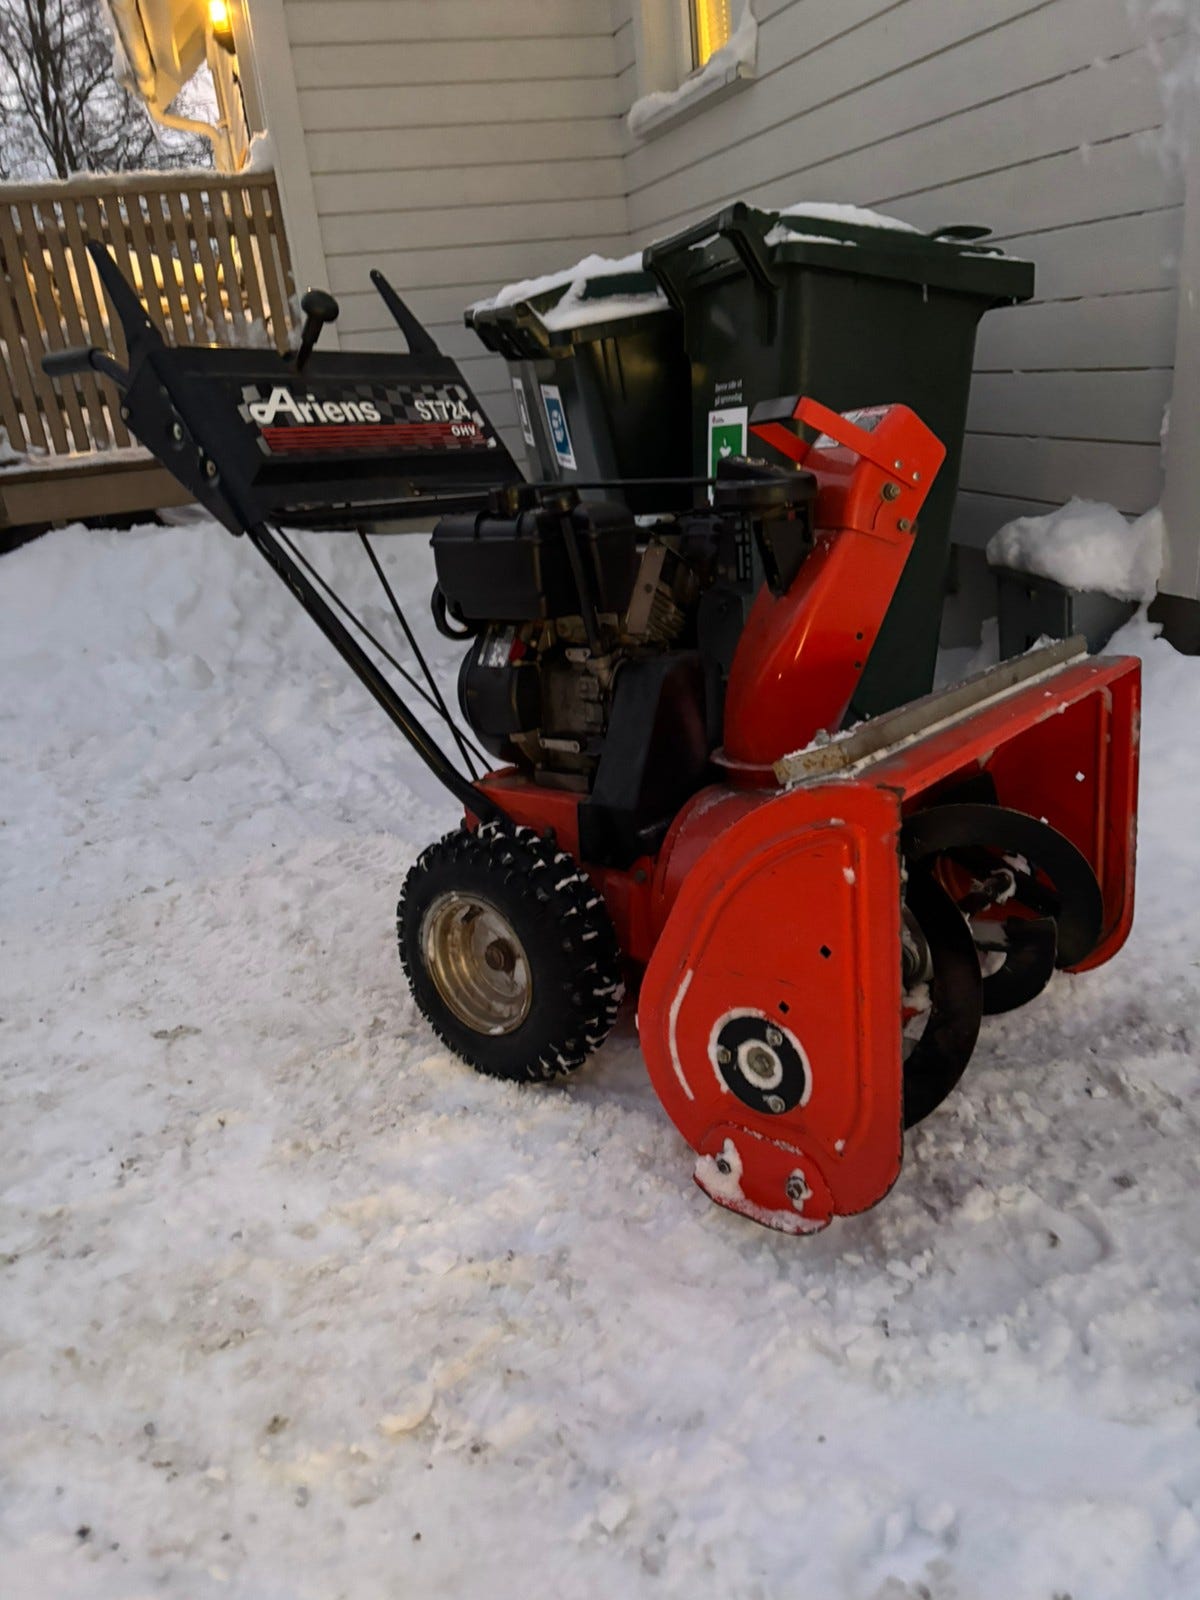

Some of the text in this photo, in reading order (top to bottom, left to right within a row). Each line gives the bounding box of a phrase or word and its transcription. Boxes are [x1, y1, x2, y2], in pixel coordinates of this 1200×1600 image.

[249, 386, 381, 424] Ariens
[414, 399, 471, 421] ST724
[451, 424, 476, 437] OHV
